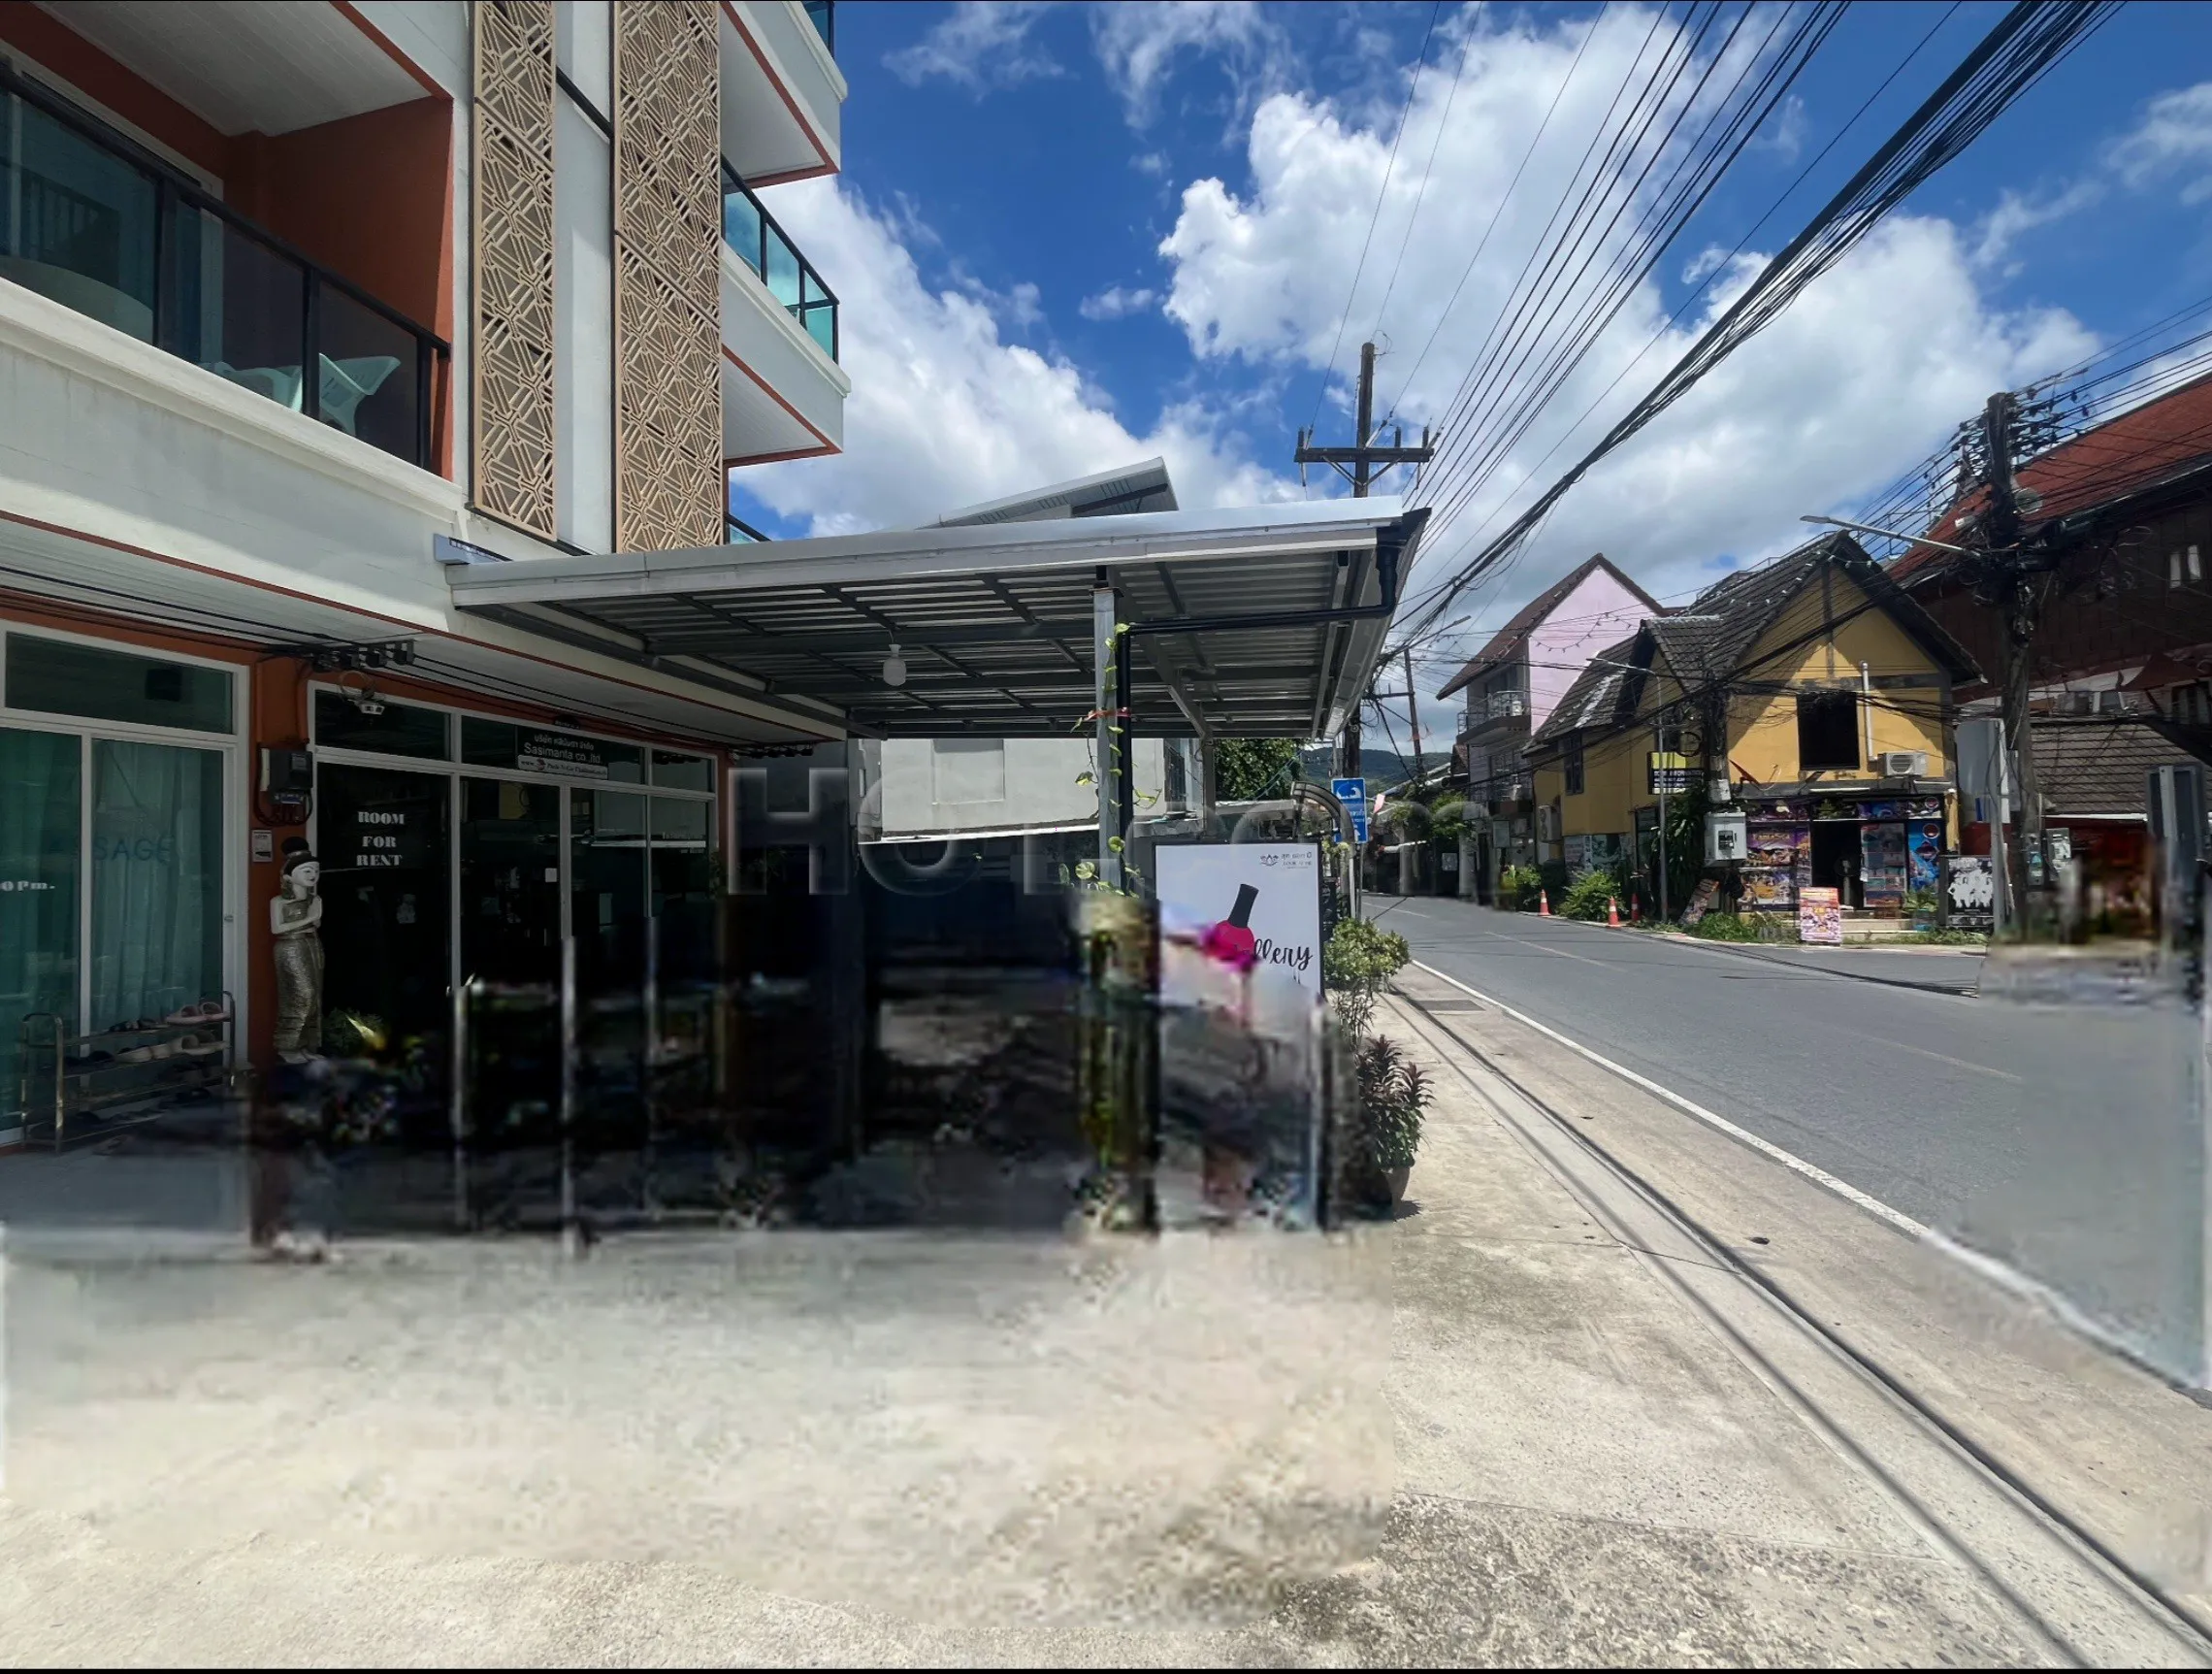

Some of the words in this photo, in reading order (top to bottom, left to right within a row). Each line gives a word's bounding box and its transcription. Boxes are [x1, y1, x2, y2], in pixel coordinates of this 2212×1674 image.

[357, 811, 406, 825] ROOM
[362, 836, 397, 848] FOR
[356, 854, 403, 866] RENT
[1253, 937, 1314, 972] llery
